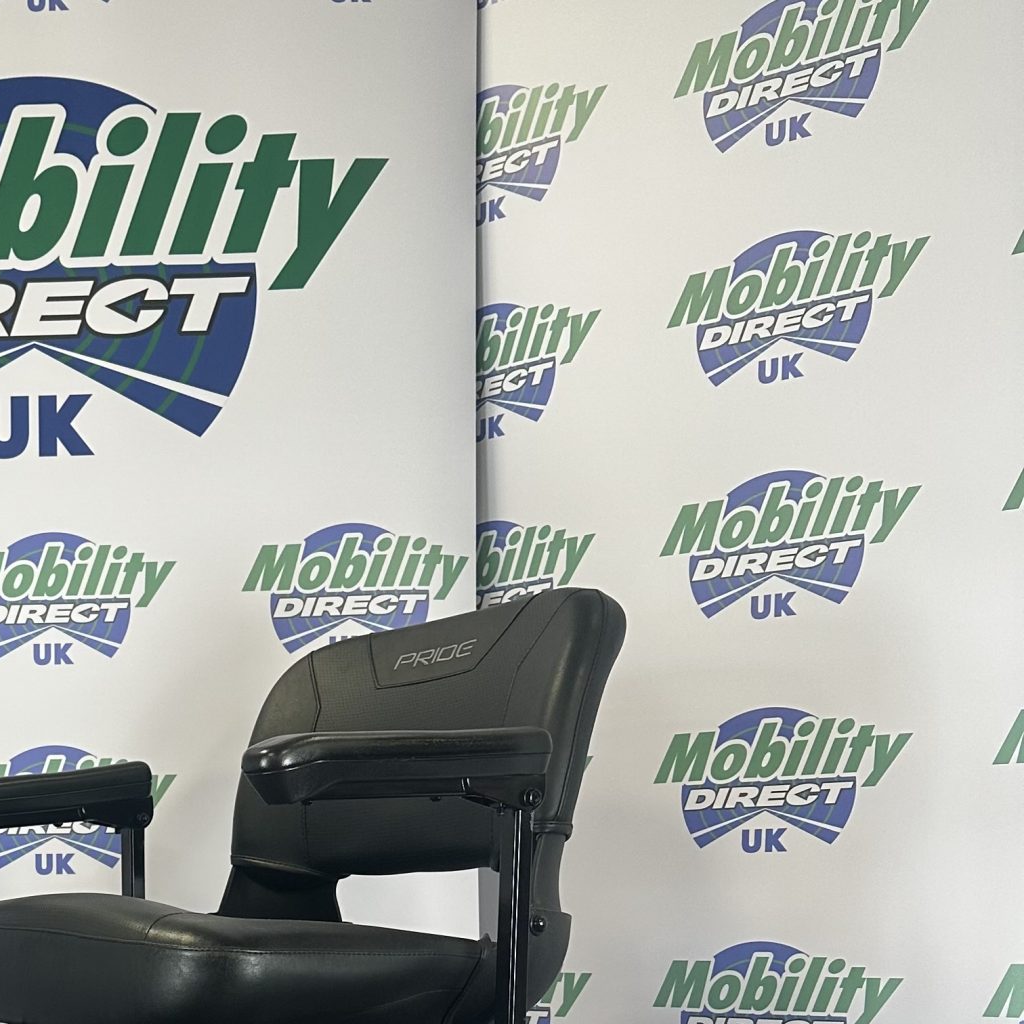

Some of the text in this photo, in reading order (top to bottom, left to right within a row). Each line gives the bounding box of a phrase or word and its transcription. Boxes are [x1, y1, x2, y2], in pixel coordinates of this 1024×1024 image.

[707, 44, 877, 118] DIRECT
[765, 116, 809, 145] UK
[667, 231, 928, 329] Mobility
[699, 297, 869, 350] DIRECT
[757, 355, 801, 384] UK
[660, 474, 920, 559] Mobility
[242, 535, 469, 603] Mobility
[690, 540, 863, 581] DIRECT
[274, 594, 426, 617] DIRECT
[751, 593, 794, 620] UK
[33, 642, 73, 666] UK
[394, 639, 477, 671] PRIDE
[655, 718, 910, 789] Mobility
[684, 783, 853, 810] DIRECT
[741, 828, 784, 854] UK
[34, 853, 74, 875] UK
